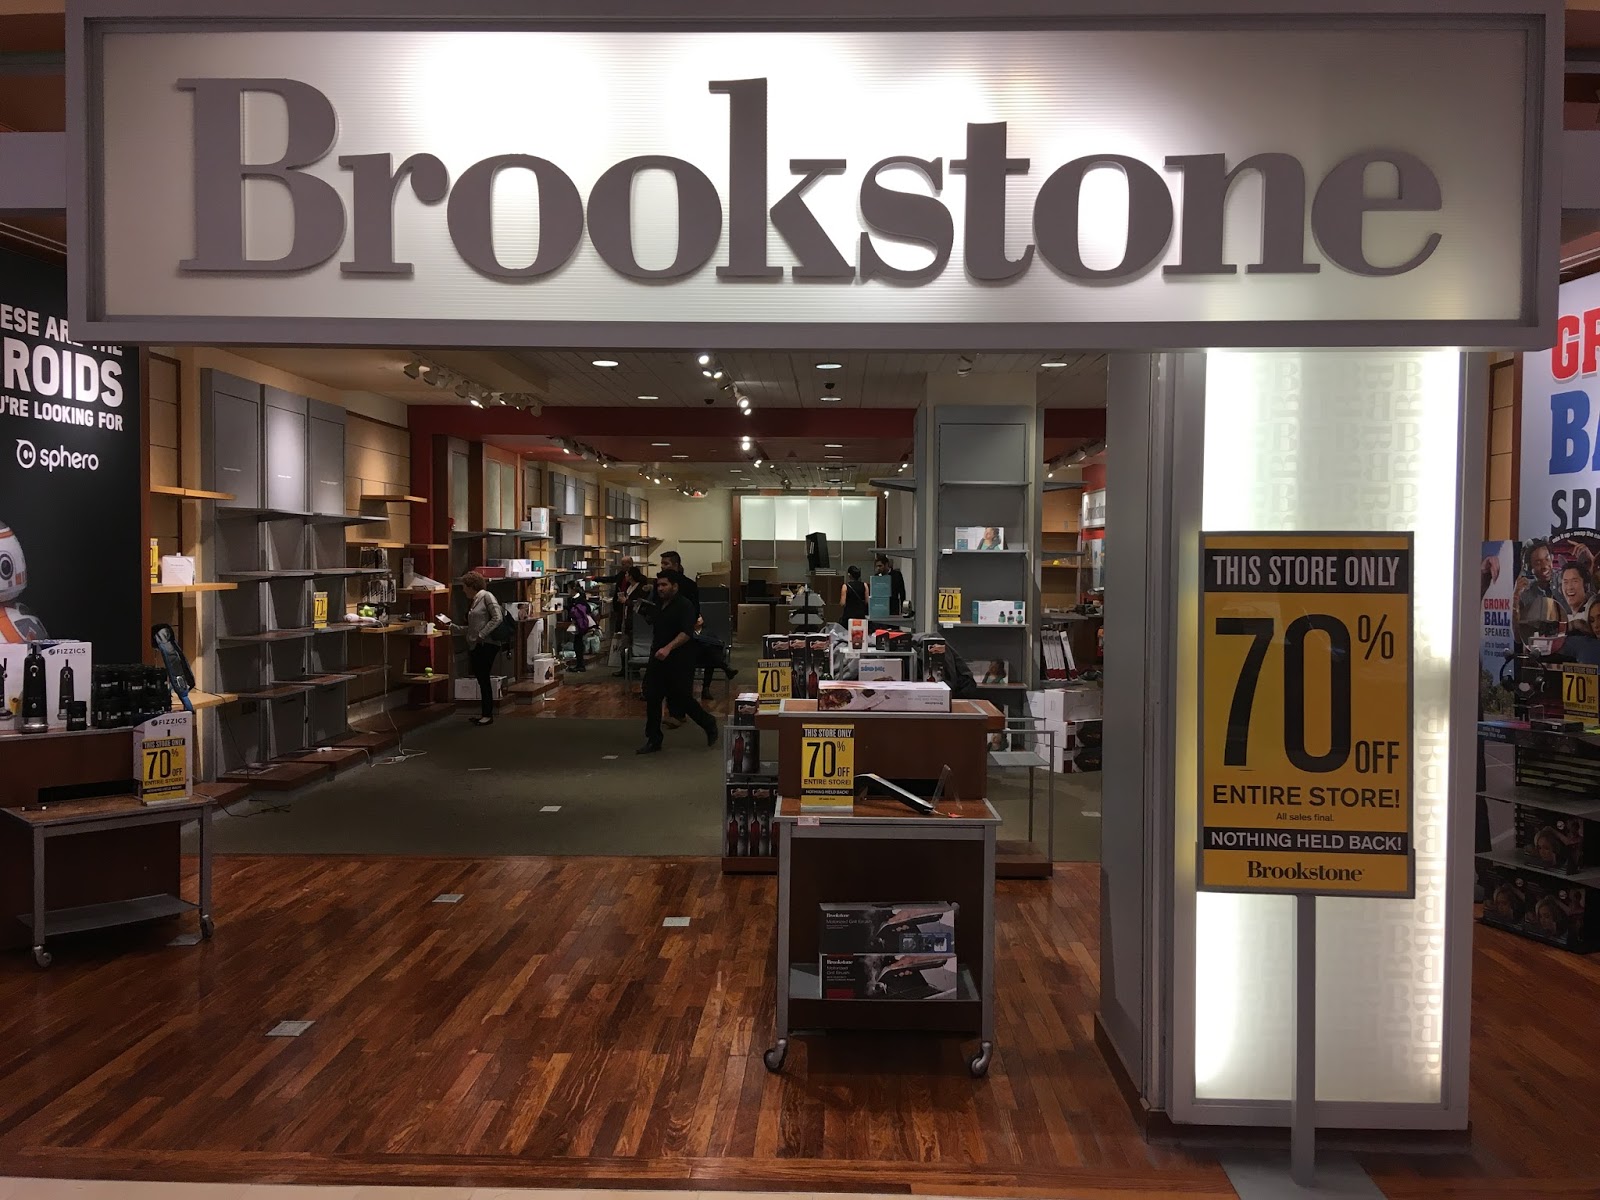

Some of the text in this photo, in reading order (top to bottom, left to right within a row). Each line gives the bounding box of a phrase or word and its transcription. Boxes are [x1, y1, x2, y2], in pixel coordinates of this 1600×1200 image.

[177, 76, 1442, 284] Brookstone
[45, 316, 83, 347] AR
[4, 337, 123, 408] ROIDS
[34, 401, 94, 427] LOOKING
[98, 412, 123, 431] FOR
[40, 445, 99, 472] sphero
[1213, 555, 1400, 587] THIS STORE ONLY
[1484, 599, 1510, 610] GRONK
[1484, 612, 1510, 626] BALL
[1485, 627, 1510, 638] SPEAKER
[804, 729, 852, 738] THIS STORE ONLY
[1355, 740, 1400, 773] OFF
[172, 768, 183, 776] OFF
[837, 767, 850, 777] OFF
[1213, 785, 1400, 808] ENTIRE STORE!
[1276, 812, 1335, 822] All sales final.
[1211, 831, 1402, 851] NOTHING HELD BACK!
[1247, 860, 1363, 882] Brookstone
